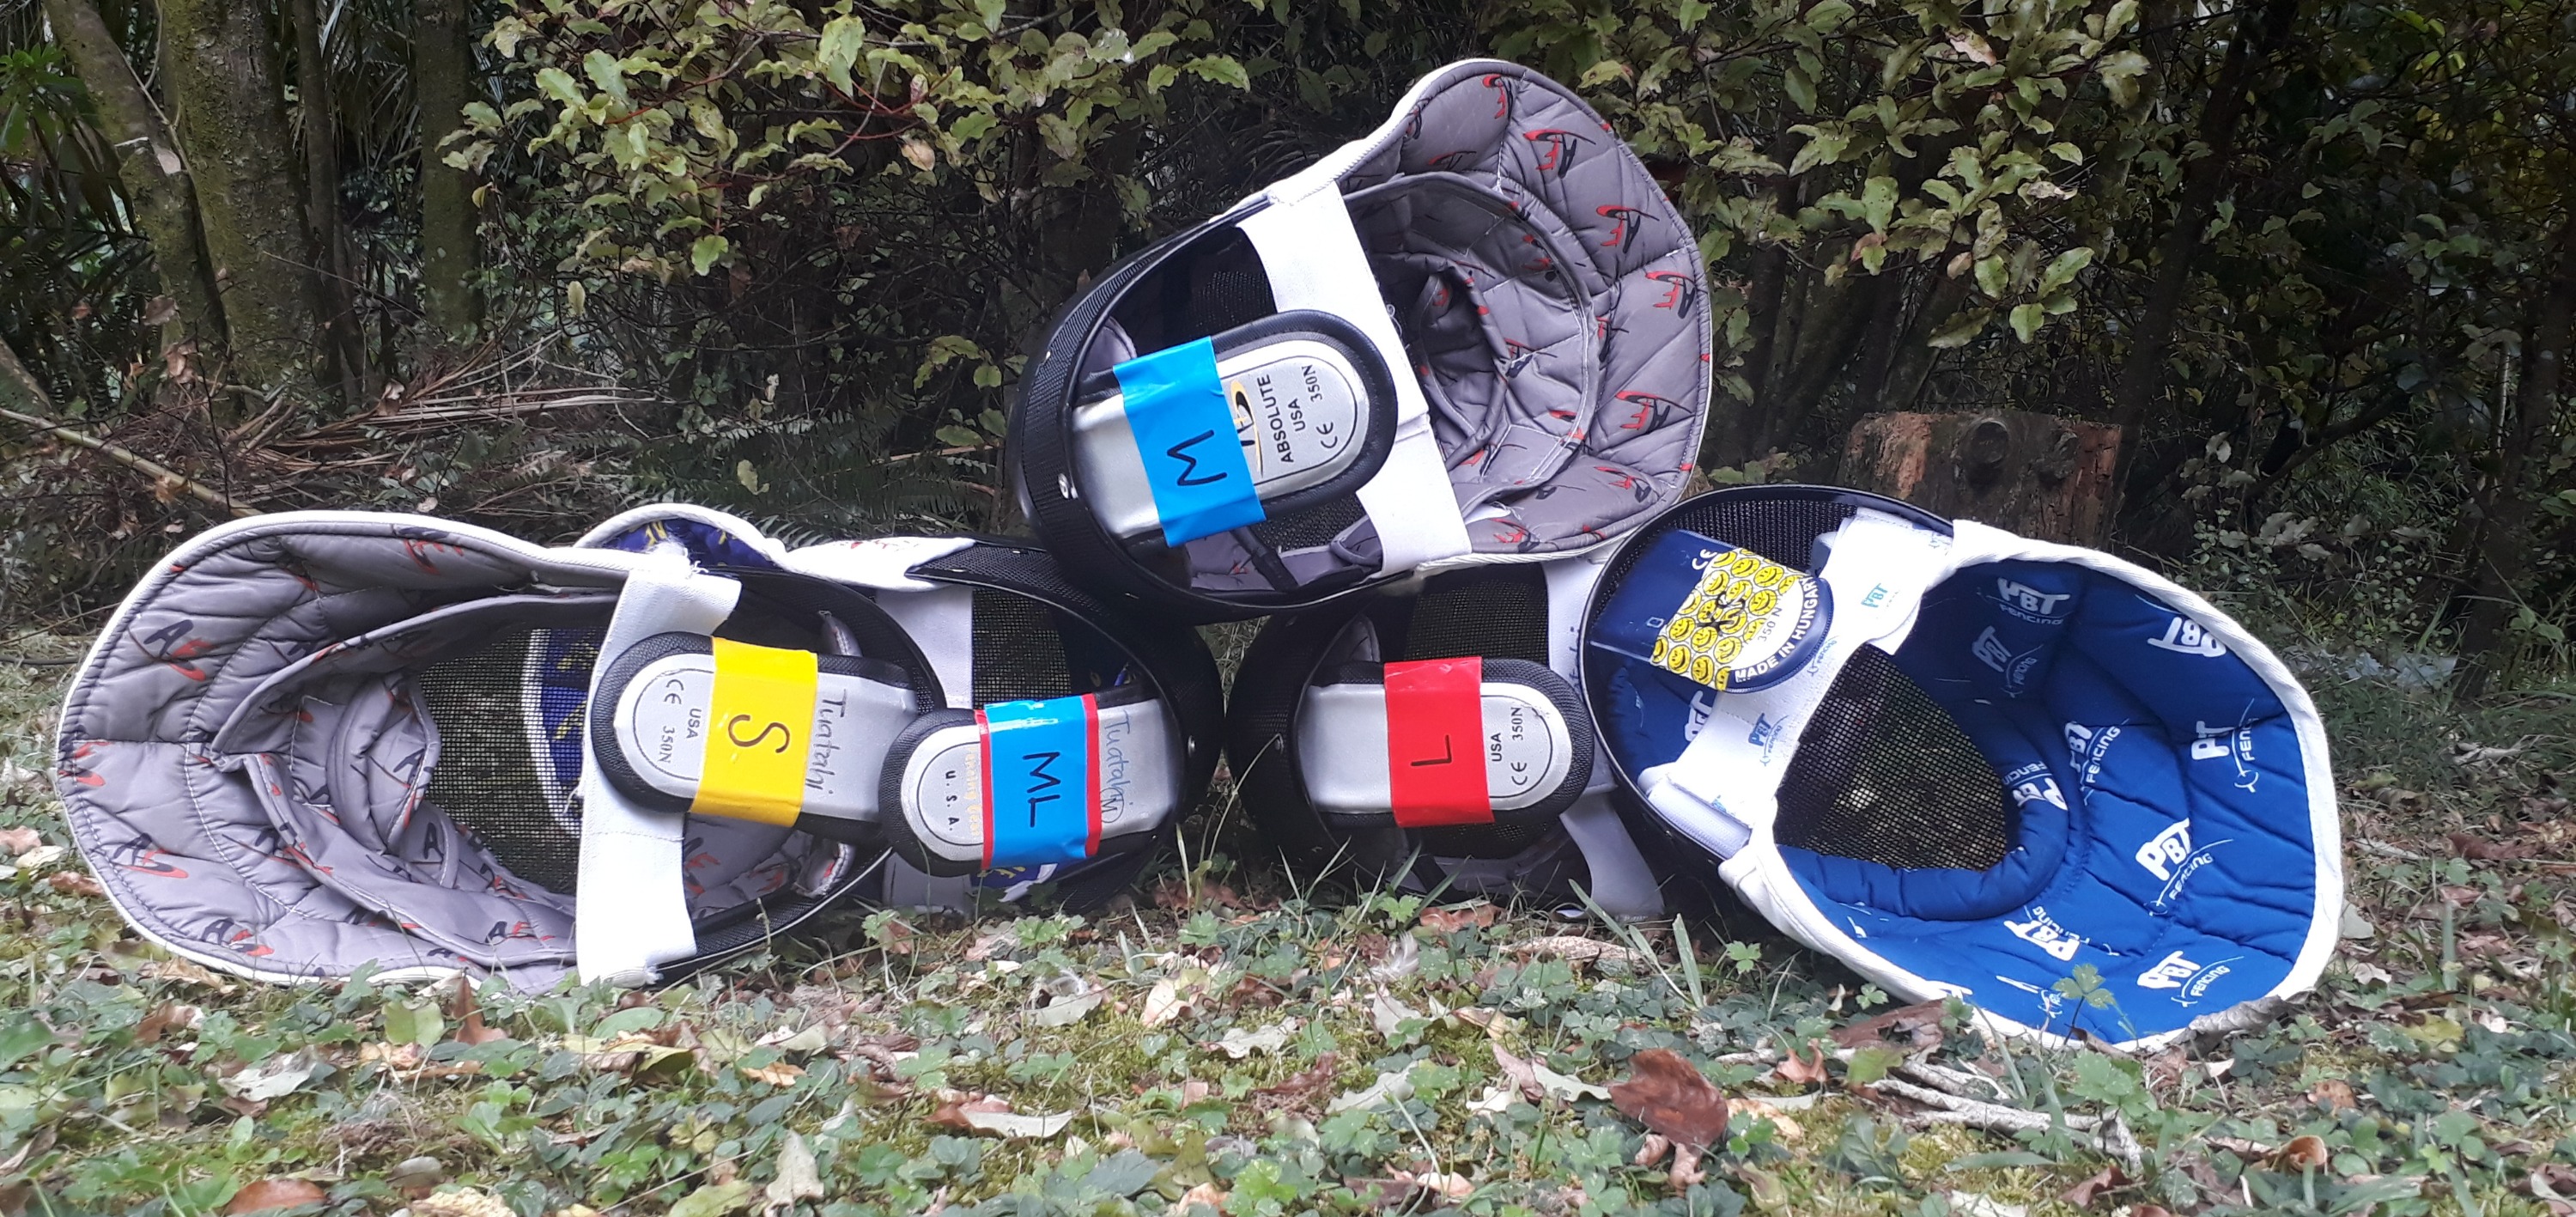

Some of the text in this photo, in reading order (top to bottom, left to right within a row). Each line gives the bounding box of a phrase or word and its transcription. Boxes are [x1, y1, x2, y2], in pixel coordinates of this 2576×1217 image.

[1301, 364, 1323, 403] 350N
[1256, 374, 1294, 463] ABSOLUTE
[1288, 398, 1306, 432] USA
[1166, 429, 1228, 487] M
[1861, 583, 1888, 608] PBT
[1735, 575, 1819, 684] MADE IN HUNGARY
[685, 709, 702, 739] USA
[727, 714, 791, 754] S
[805, 688, 847, 798] Tuatahi
[1510, 706, 1524, 741] 350N
[658, 725, 676, 765] 350N
[1411, 734, 1452, 767] L
[1491, 733, 1503, 763] USA
[2086, 726, 2122, 784] FENCING
[1022, 751, 1062, 828] ML
[2136, 818, 2214, 901] PBT FENCING
[2003, 920, 2081, 962] PBT
[2137, 950, 2231, 998] PBT FENCING
